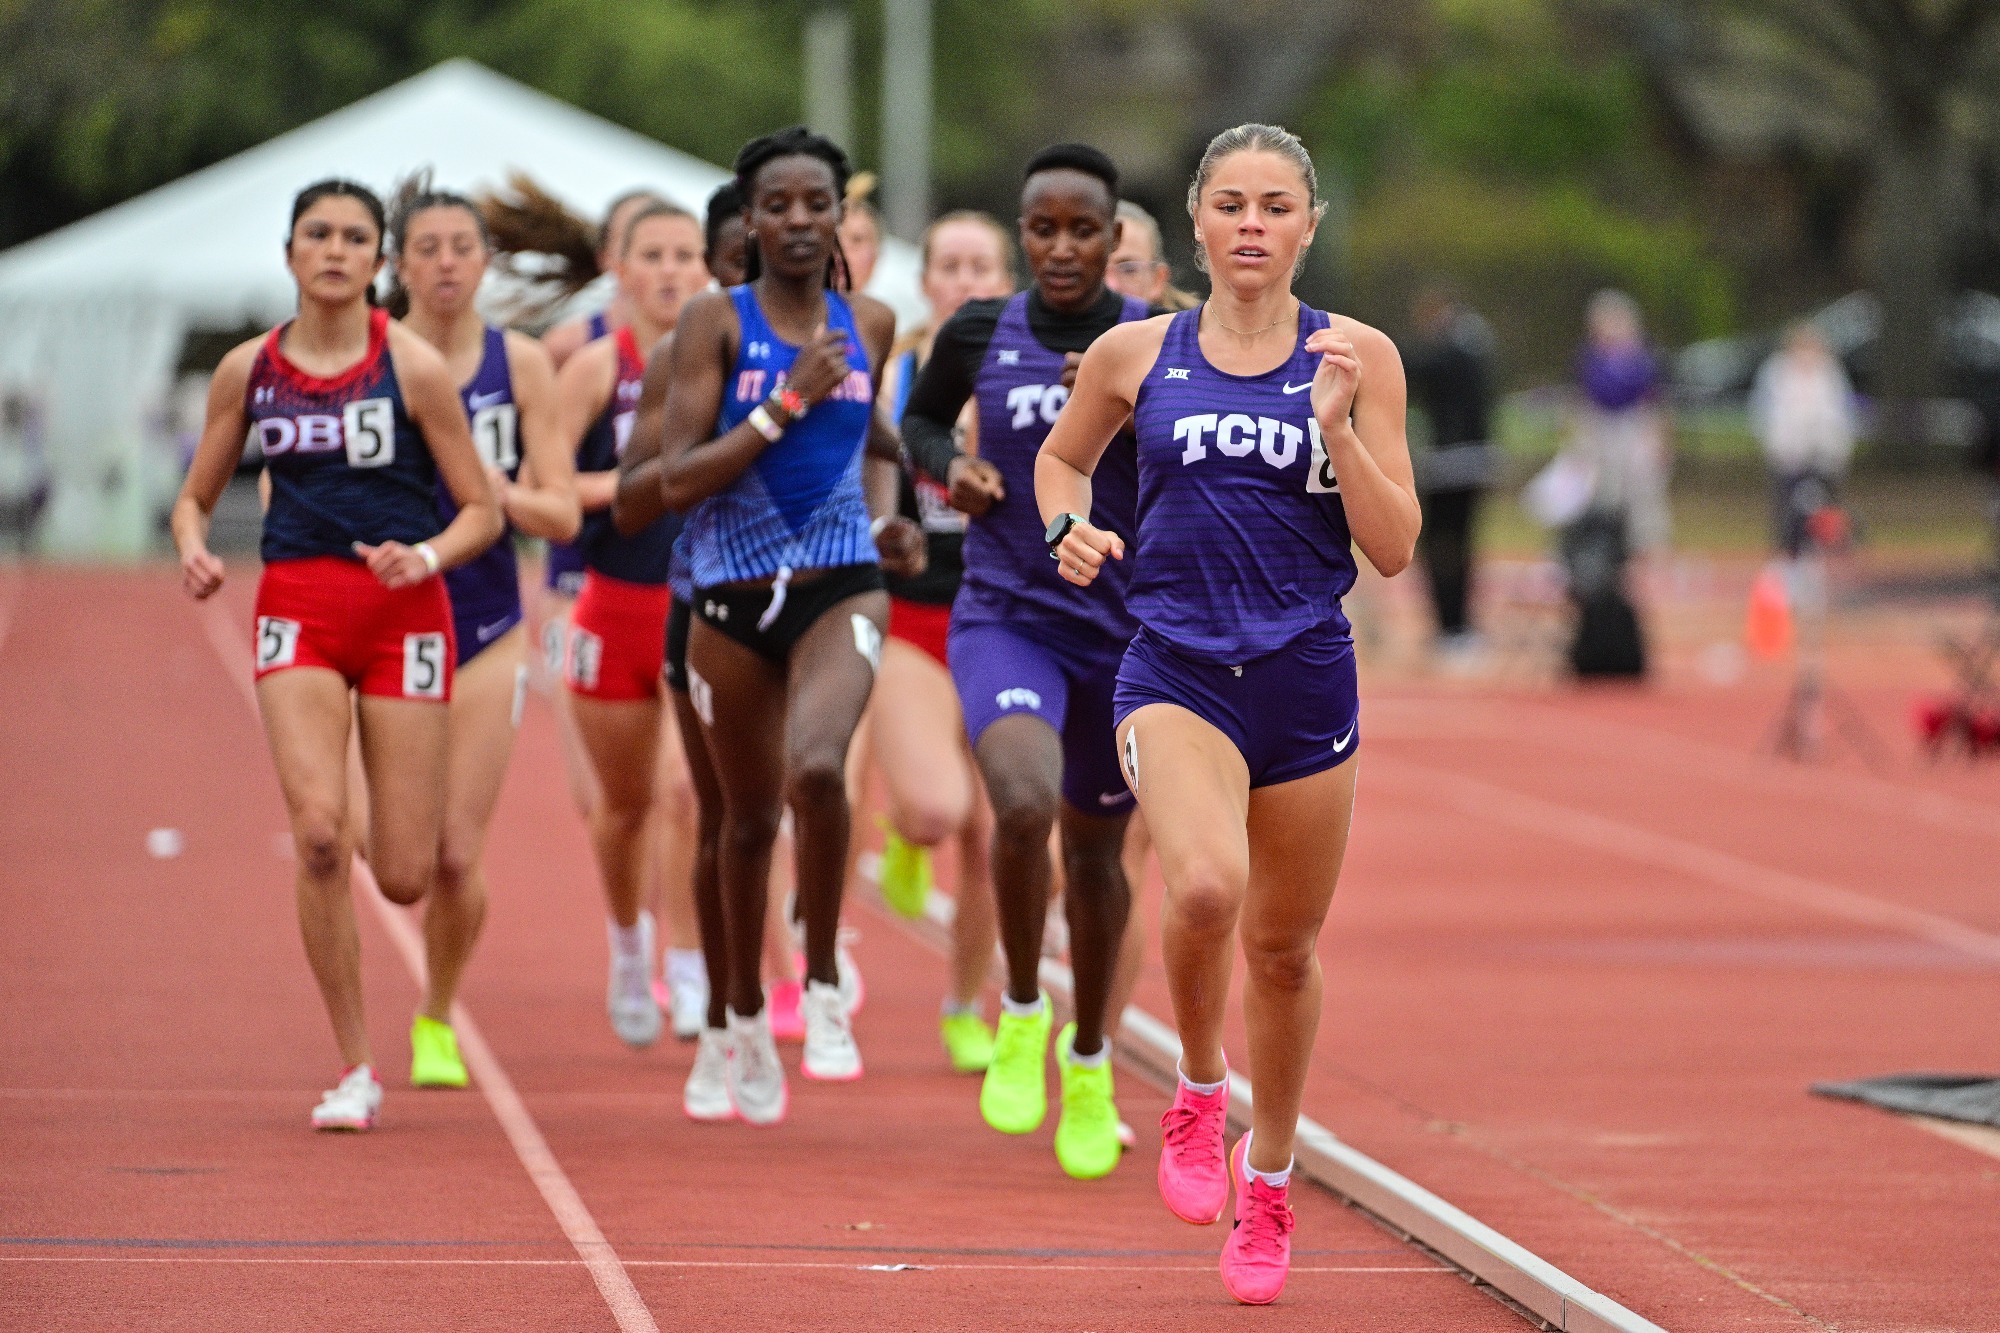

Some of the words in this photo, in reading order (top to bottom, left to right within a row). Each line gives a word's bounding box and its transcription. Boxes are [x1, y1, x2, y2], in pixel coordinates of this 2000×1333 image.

[736, 369, 766, 402] UT
[1006, 384, 1070, 430] TC
[258, 415, 345, 457] DB
[359, 408, 382, 459] 5
[1173, 413, 1303, 470] TCU
[263, 618, 287, 662] 5
[413, 638, 435, 690] 5
